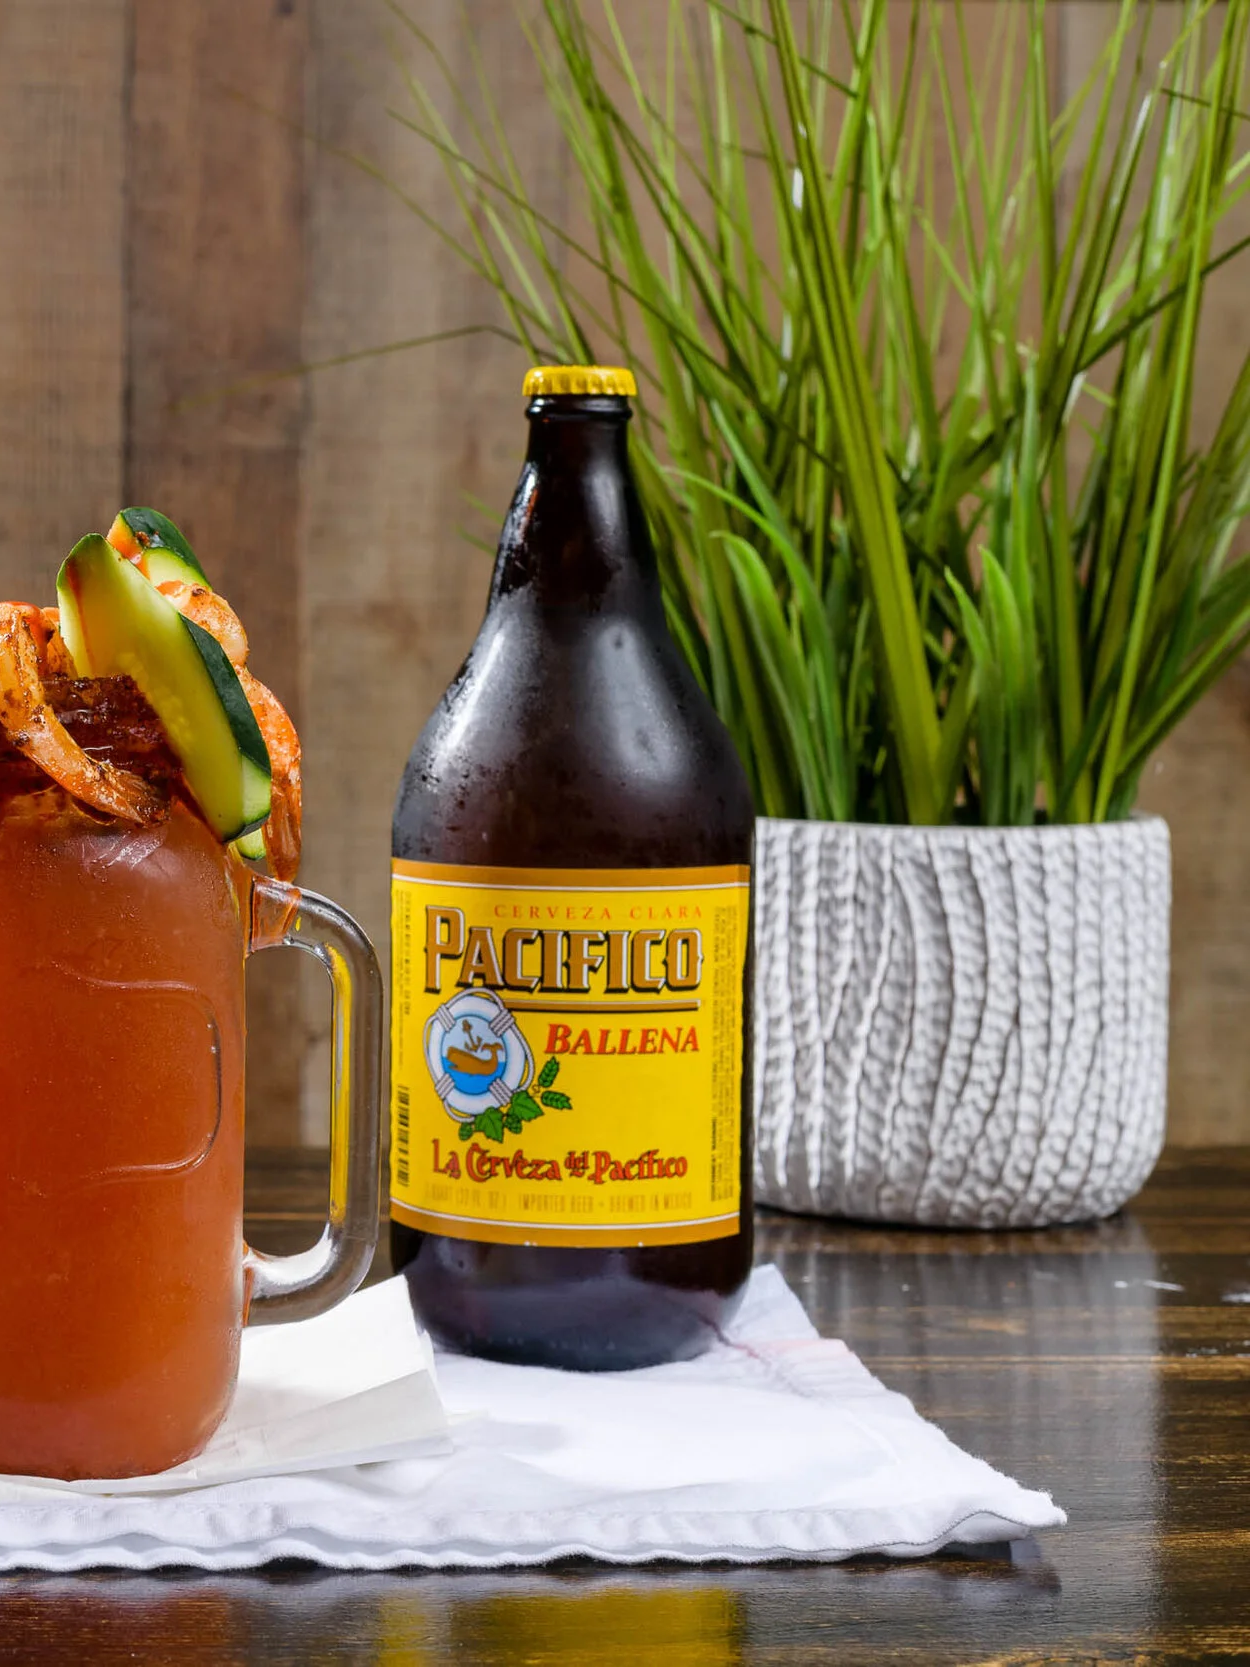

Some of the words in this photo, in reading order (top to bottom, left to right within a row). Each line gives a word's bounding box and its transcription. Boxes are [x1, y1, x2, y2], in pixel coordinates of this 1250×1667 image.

[494, 904, 612, 920] CERVEZA
[629, 905, 702, 920] CLARA
[423, 904, 705, 995] PACIFICO
[544, 1022, 700, 1056] BALLENA
[432, 1138, 462, 1180] La
[466, 1142, 563, 1183] Cerveza
[564, 1151, 589, 1178] del
[587, 1149, 689, 1185] Pacifico
